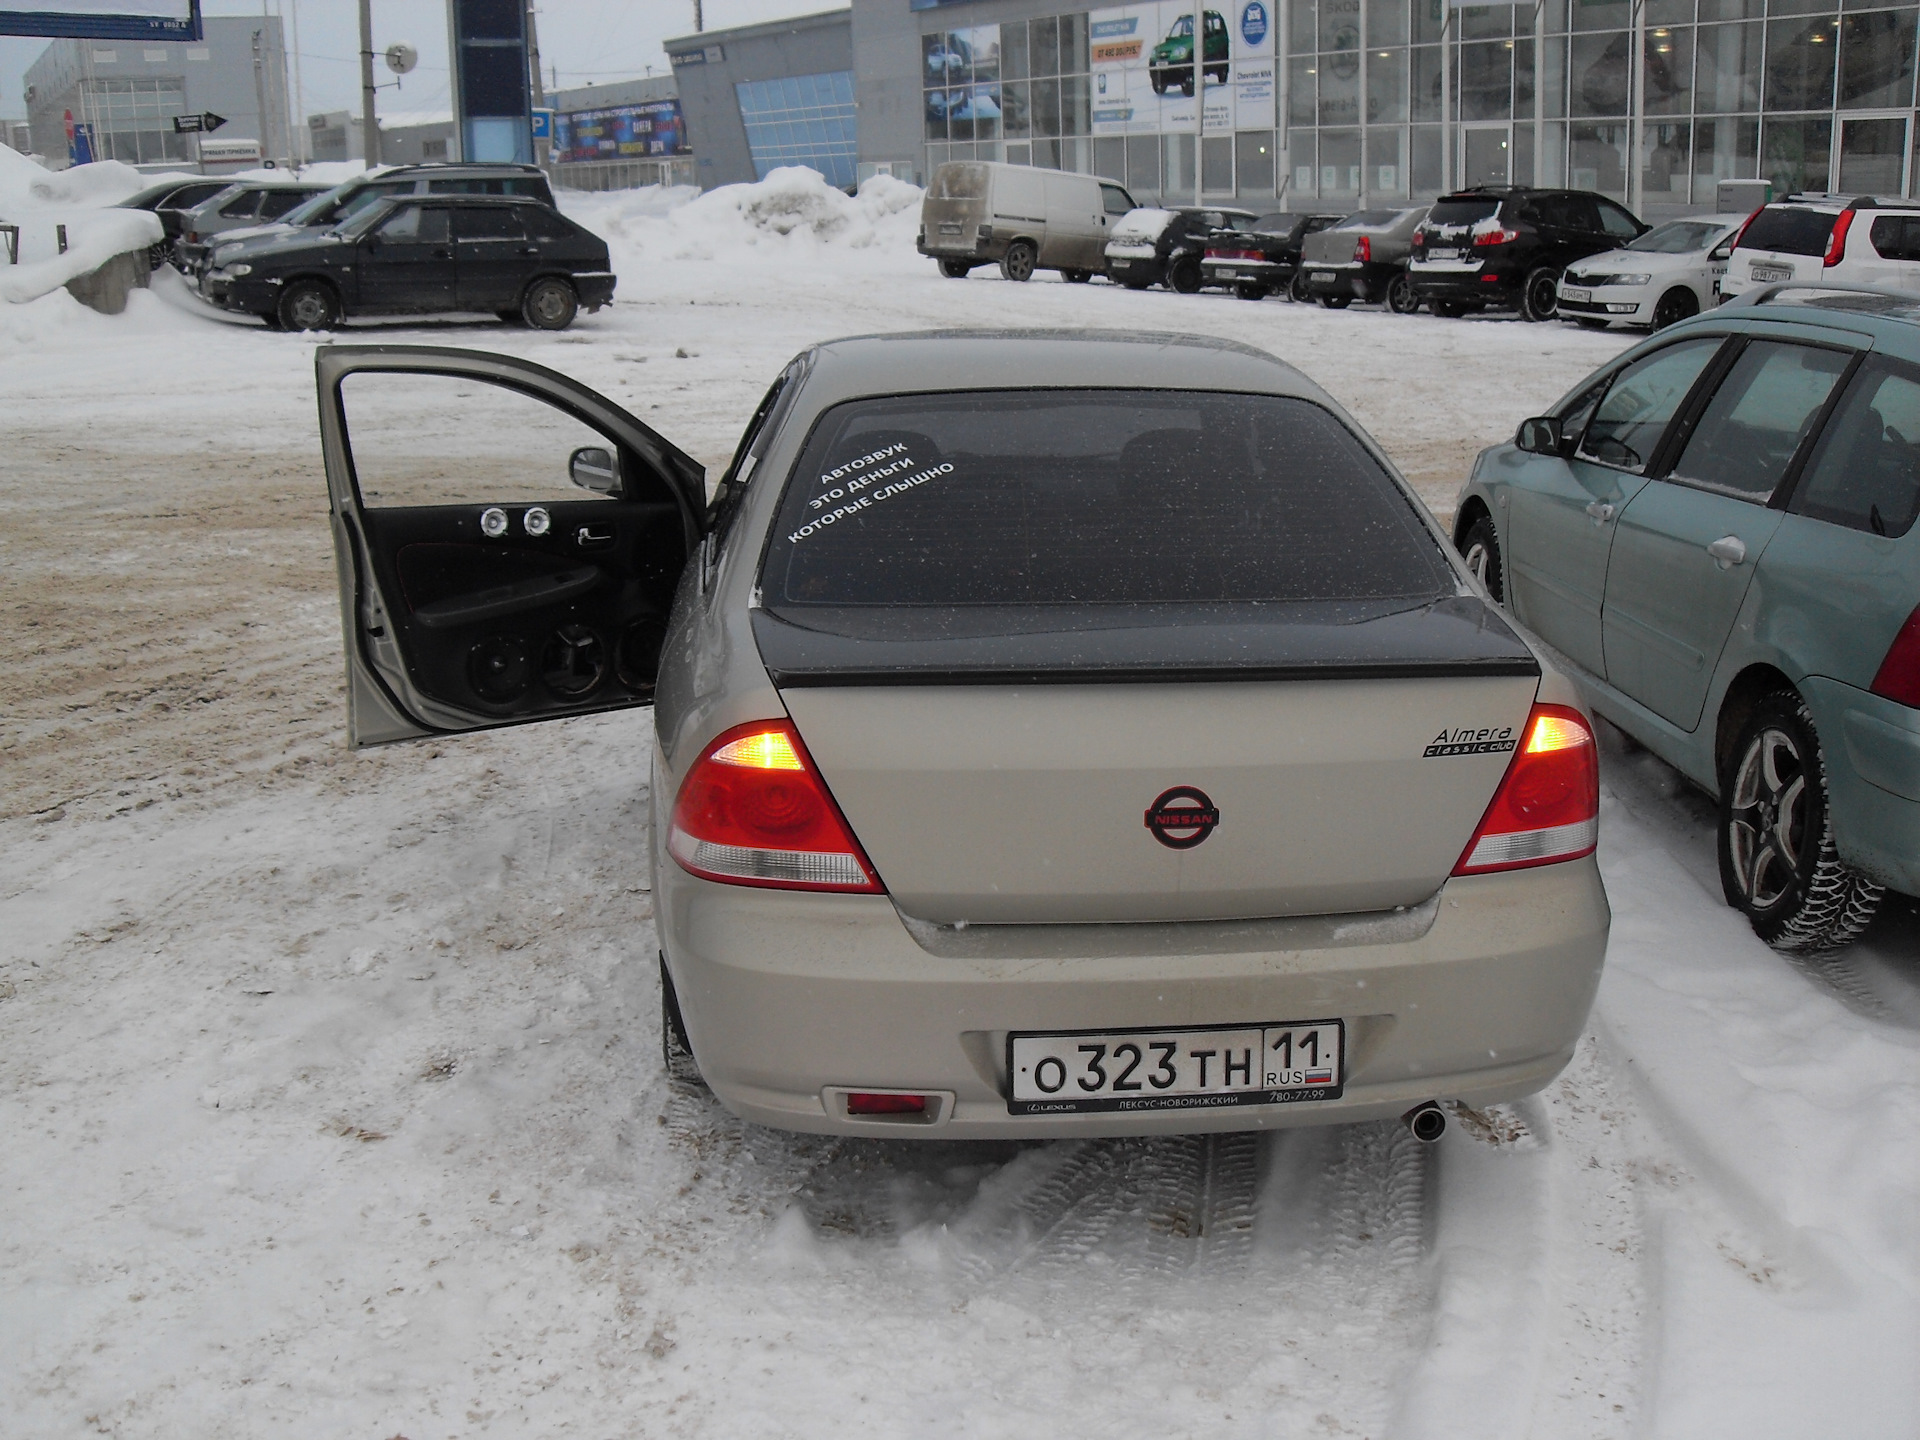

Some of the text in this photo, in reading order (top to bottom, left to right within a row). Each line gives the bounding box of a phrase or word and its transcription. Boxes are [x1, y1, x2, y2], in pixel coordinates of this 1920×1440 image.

[821, 442, 908, 484] АВТОЗВУК
[809, 457, 915, 510] ЭТО ДЕНЬГИ
[788, 463, 955, 544] КОТОРЫЕ СЛЫШНО
[1432, 727, 1512, 744] Almera
[1489, 741, 1513, 752] club
[1155, 814, 1213, 825] NISSAN
[1272, 1031, 1318, 1068] 11
[1266, 1070, 1303, 1086] RUS
[1269, 1089, 1326, 1102] 780-77-99
